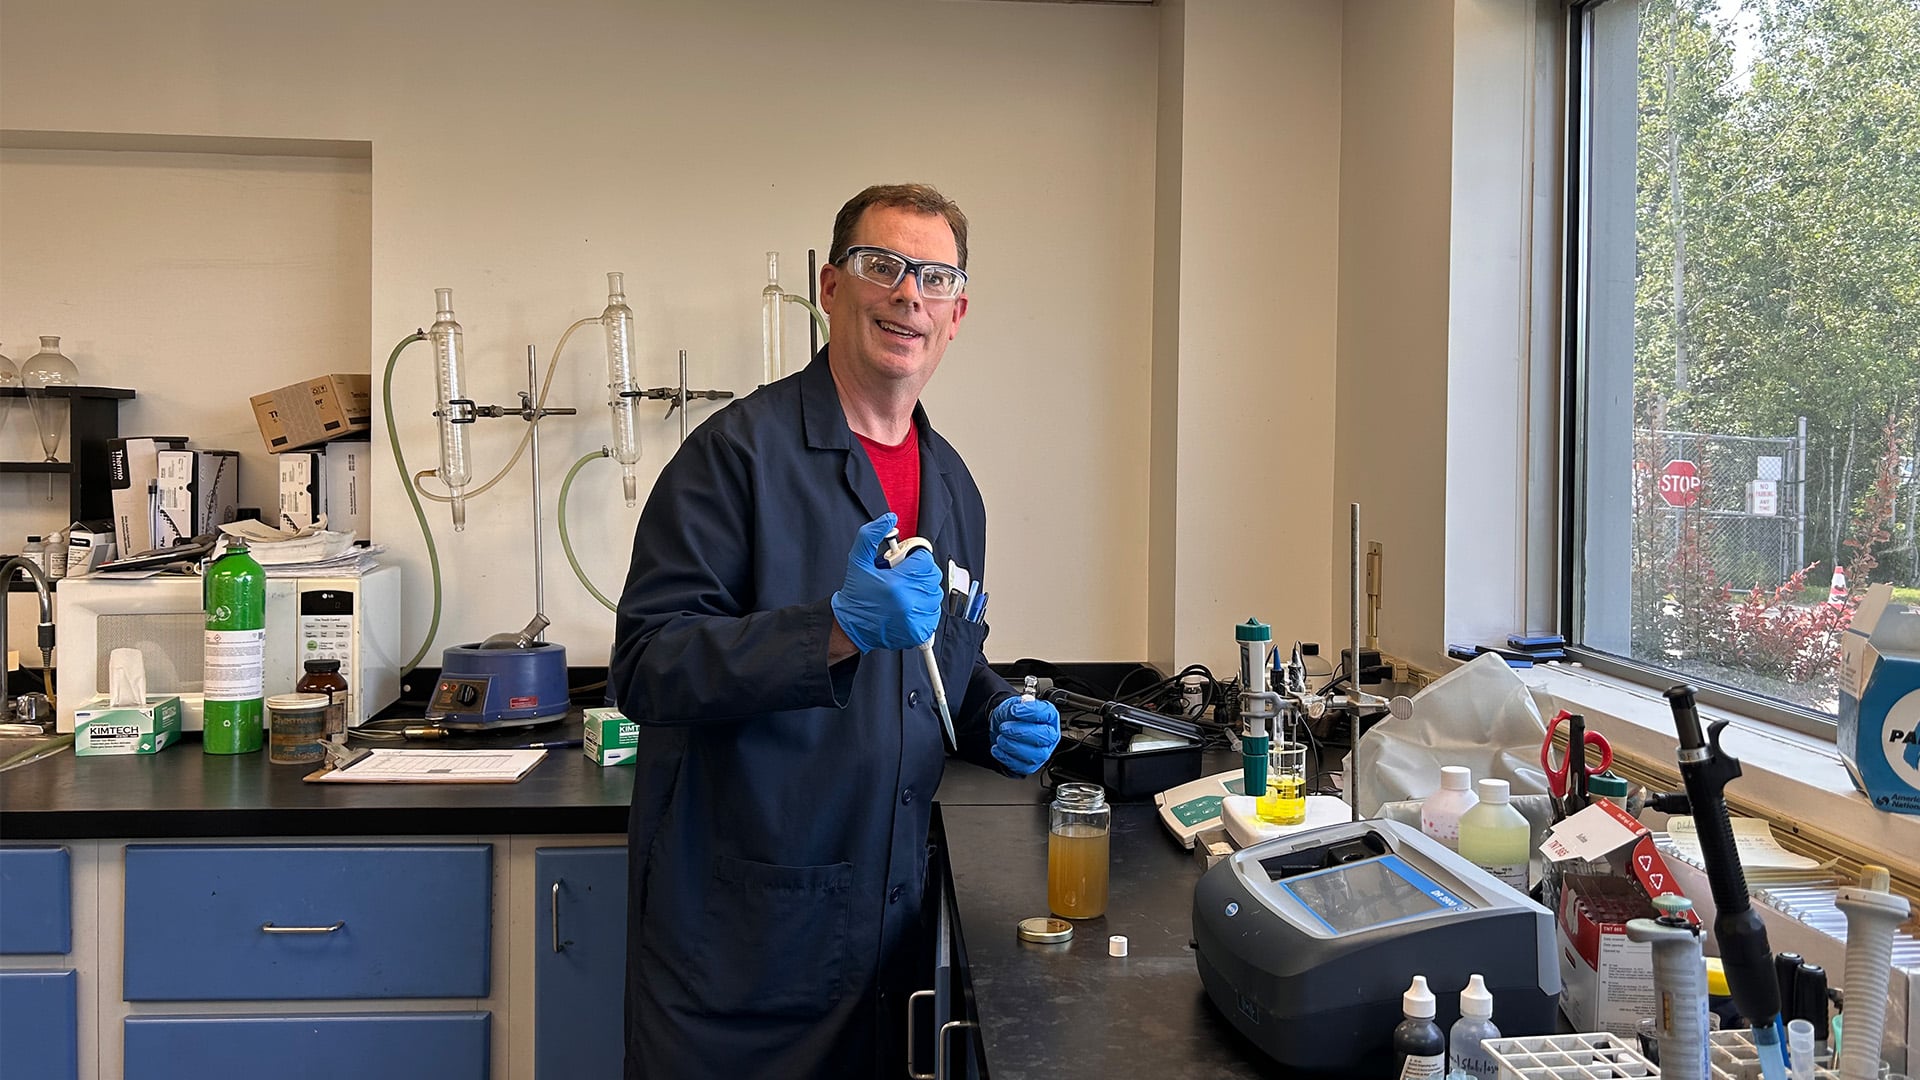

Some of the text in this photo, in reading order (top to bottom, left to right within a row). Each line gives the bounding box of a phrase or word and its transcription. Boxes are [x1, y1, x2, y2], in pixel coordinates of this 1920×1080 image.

[115, 449, 124, 481] Thermo
[1661, 474, 1701, 493] STOP
[89, 726, 139, 735] KIMTECH
[619, 725, 641, 733] KIMT
[1889, 729, 1920, 744] PA
[1891, 793, 1920, 802] Americ
